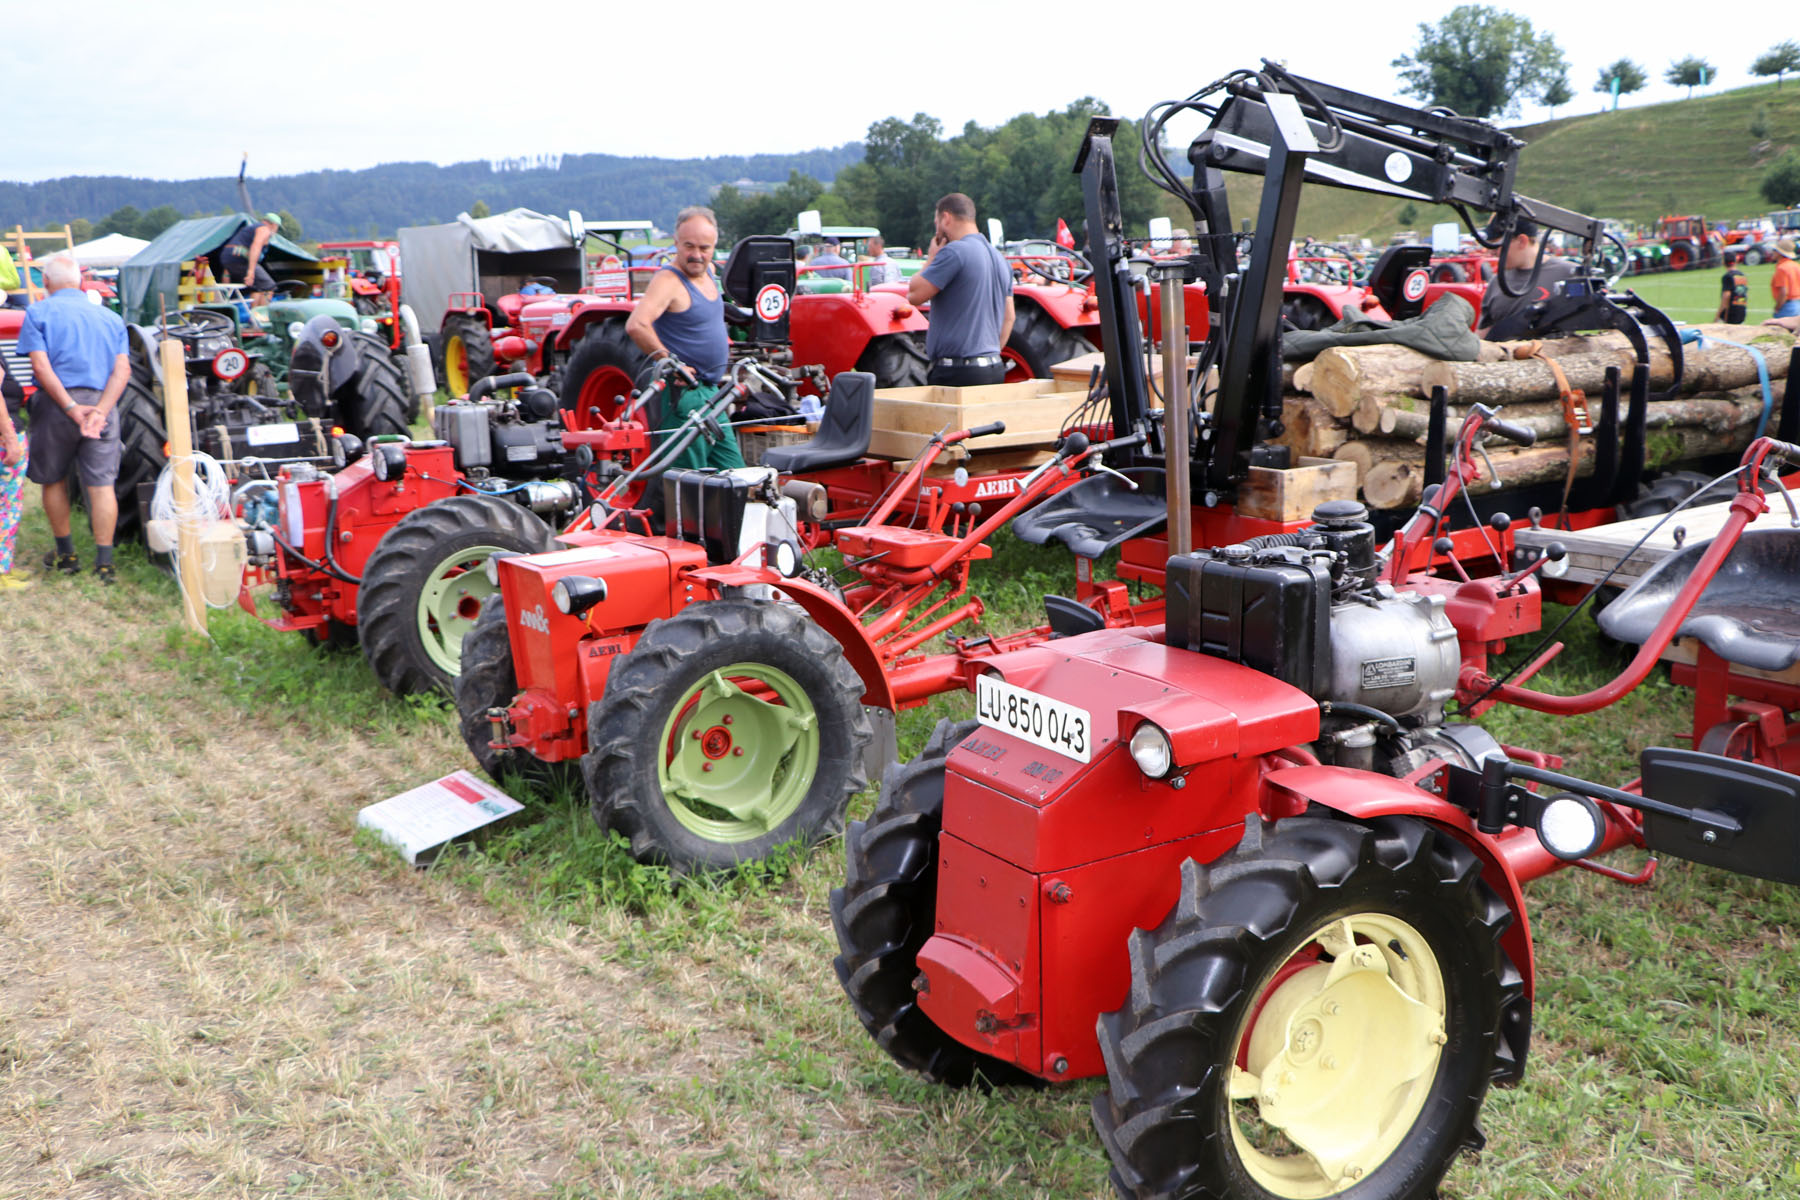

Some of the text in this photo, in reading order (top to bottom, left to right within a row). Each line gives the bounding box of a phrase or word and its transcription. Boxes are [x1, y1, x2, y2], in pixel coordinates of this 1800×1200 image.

[765, 295, 780, 311] 25
[223, 356, 239, 371] 20
[975, 479, 1015, 497] AEBI
[589, 644, 622, 657] AEBI
[960, 738, 1007, 761] AEBI
